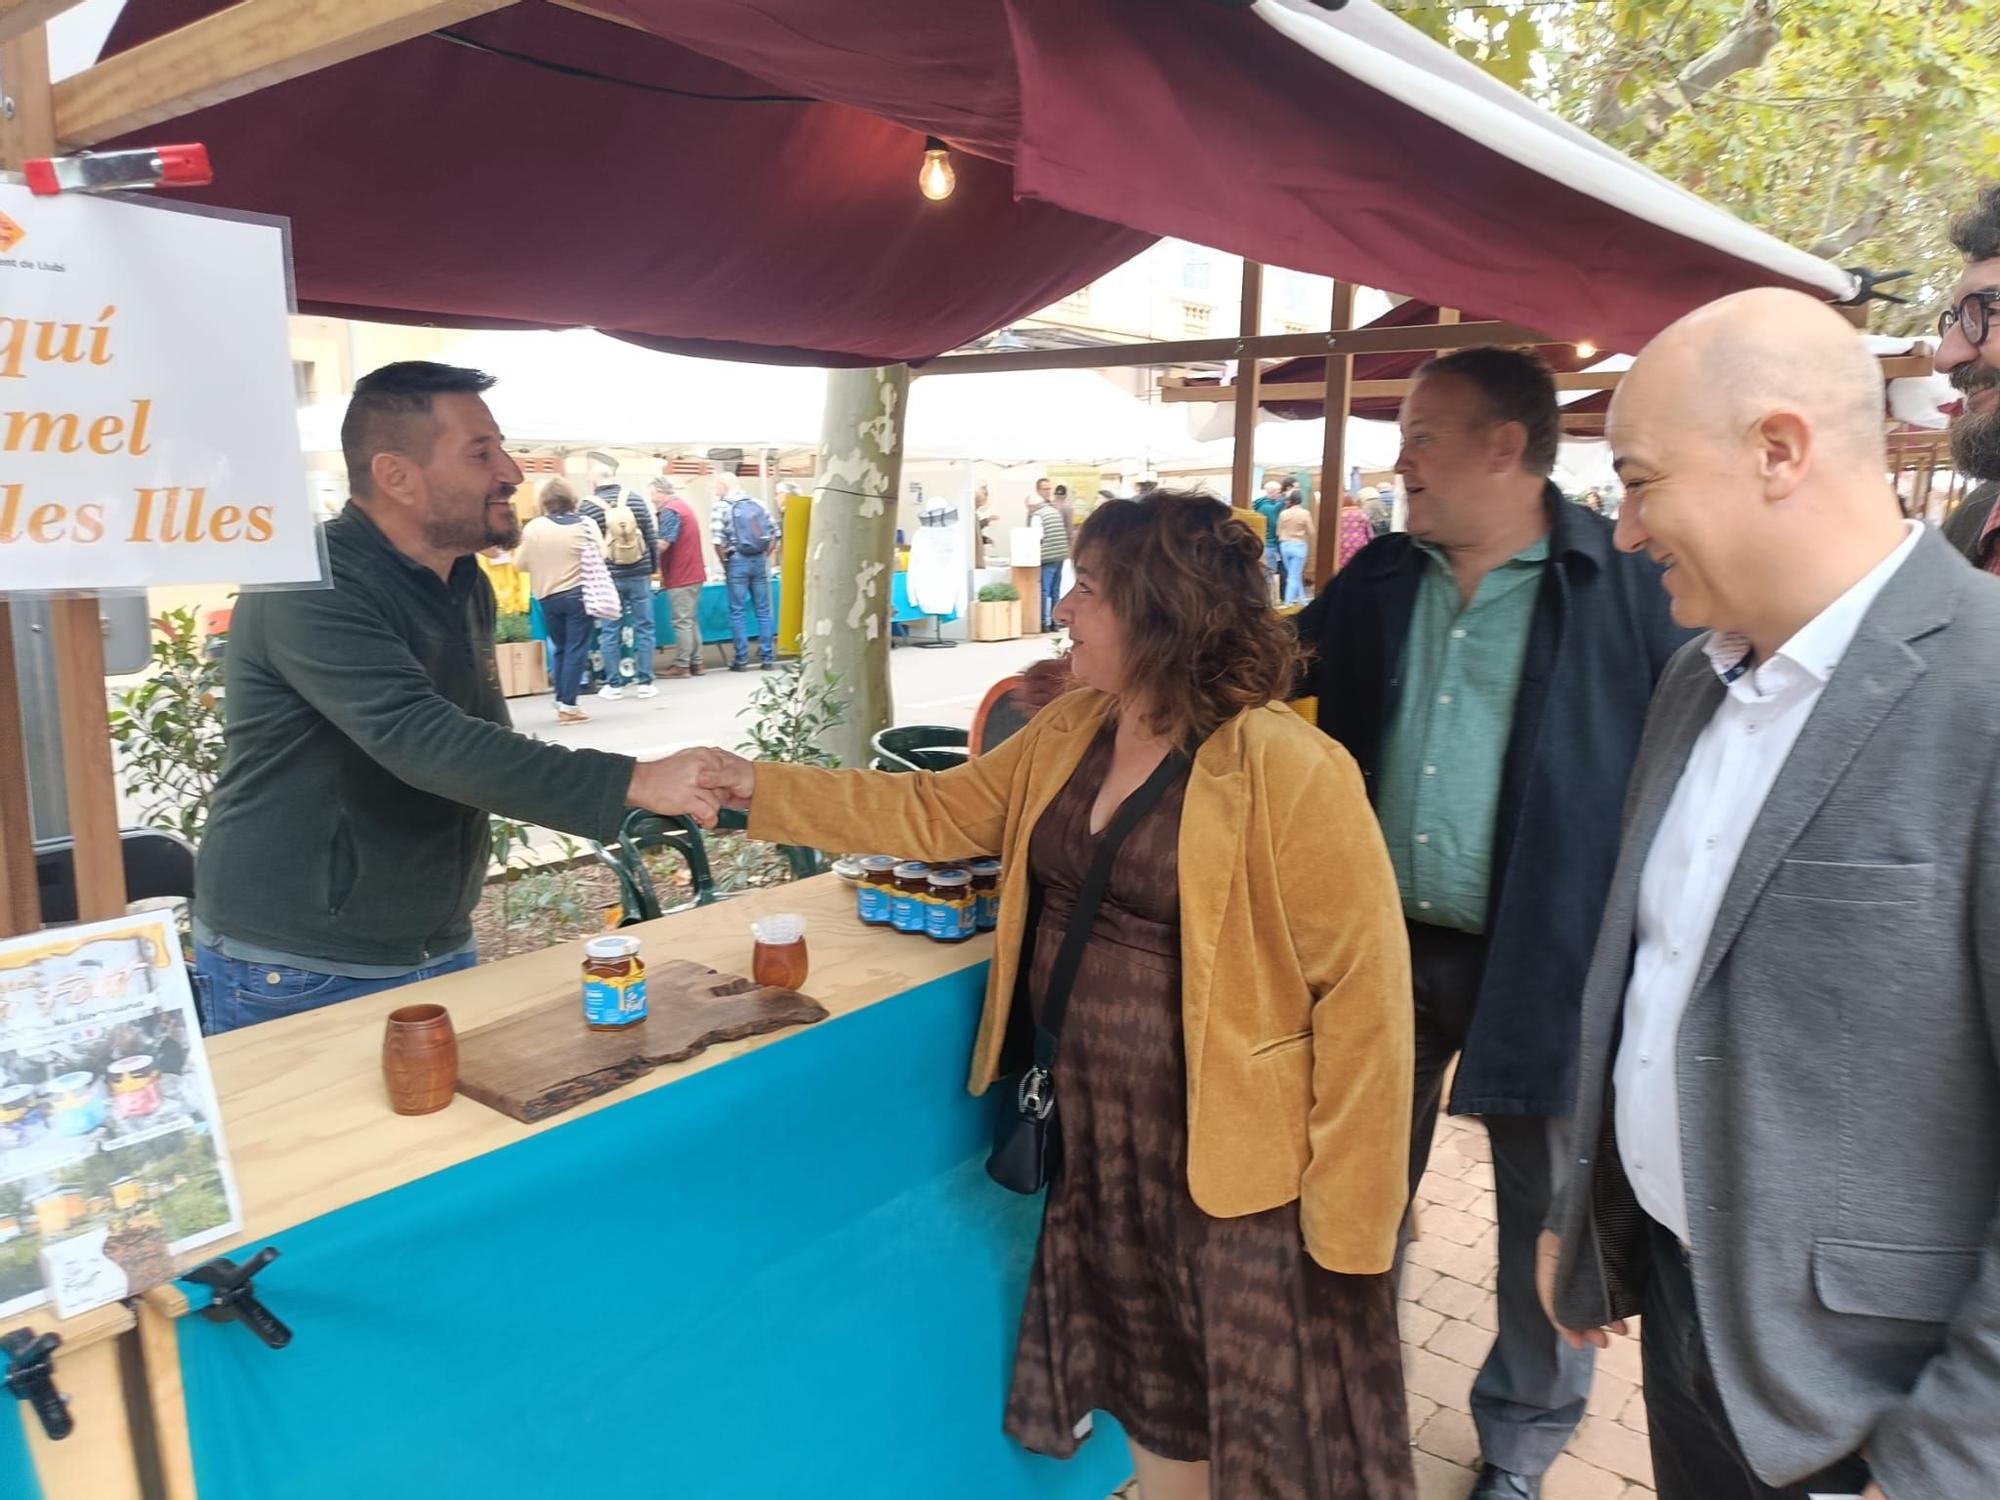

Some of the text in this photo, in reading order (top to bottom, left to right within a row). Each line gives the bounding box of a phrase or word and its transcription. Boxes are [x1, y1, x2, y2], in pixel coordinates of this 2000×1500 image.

[0, 304, 116, 378] quí
[3, 399, 152, 455] mel
[0, 484, 274, 543] les Illes
